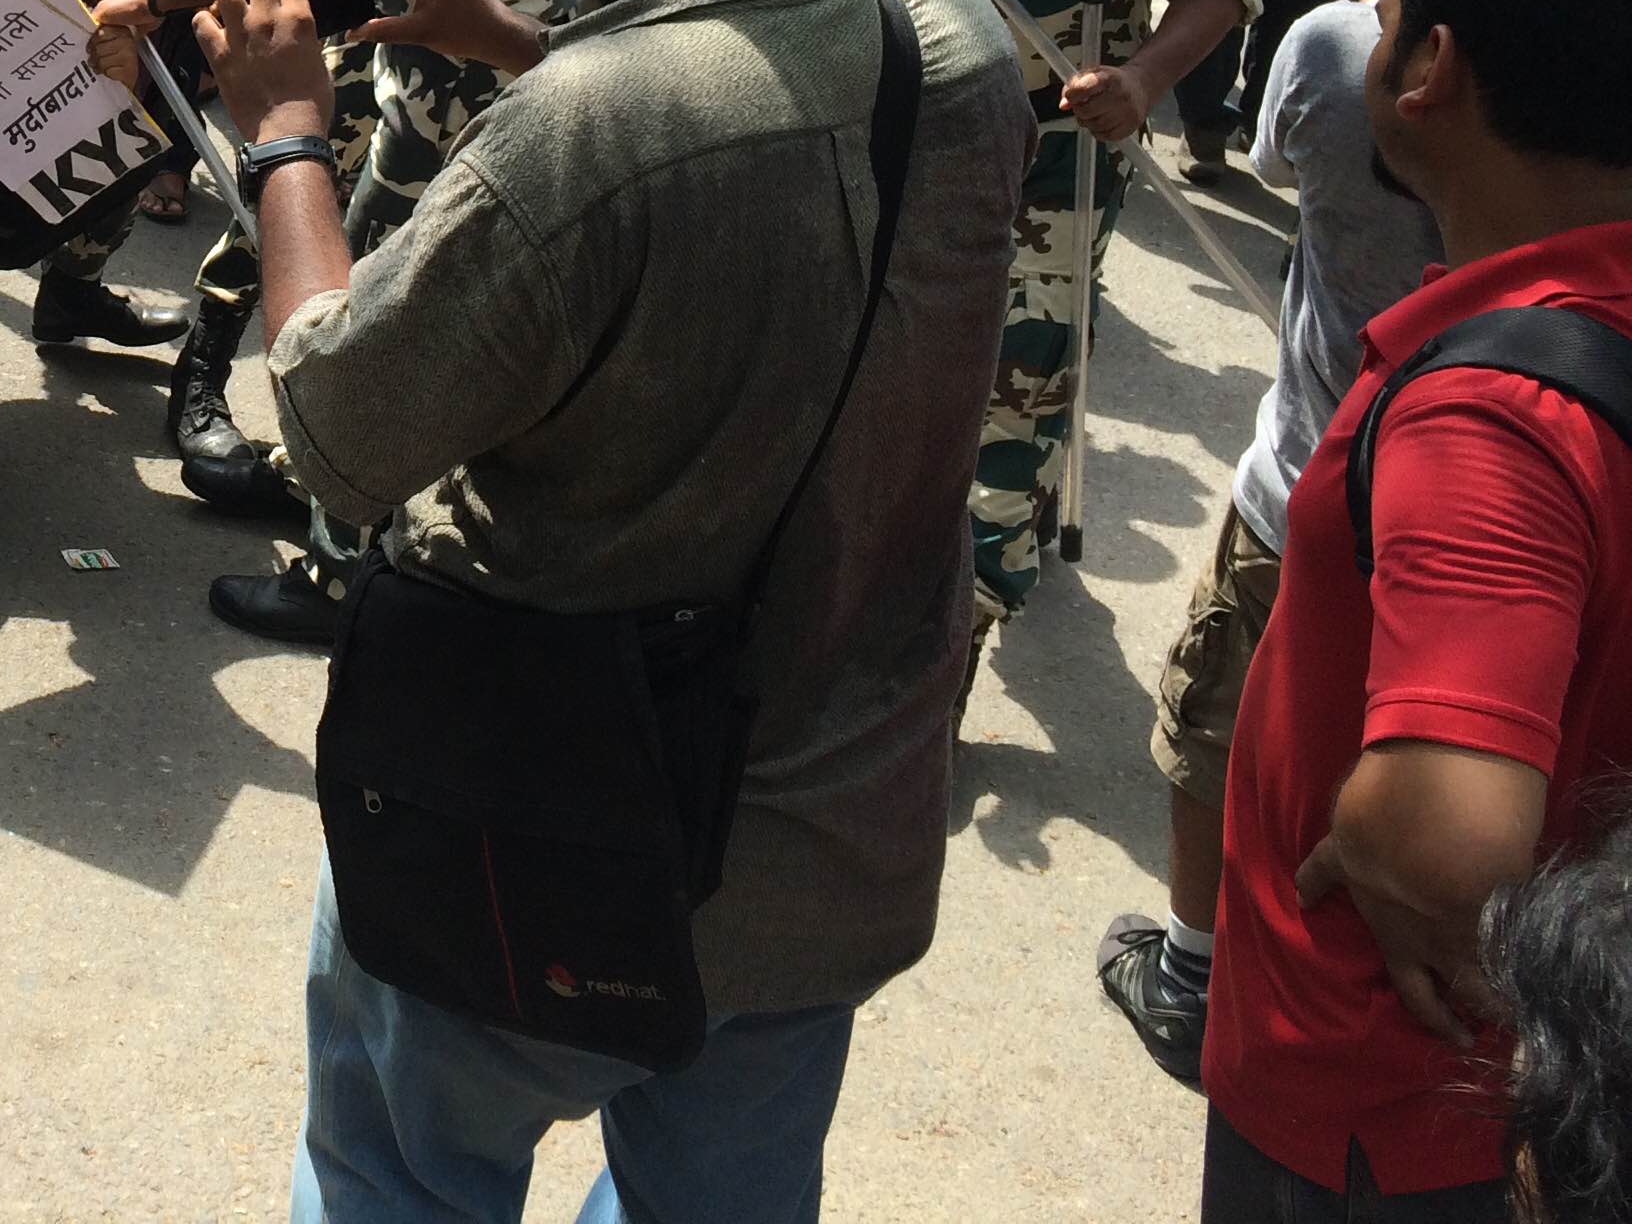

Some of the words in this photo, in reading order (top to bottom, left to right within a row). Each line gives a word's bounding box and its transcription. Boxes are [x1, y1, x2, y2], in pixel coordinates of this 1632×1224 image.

[11, 33, 75, 81] सरकार
[2, 60, 97, 154] मुर्दाबाद!!
[29, 109, 163, 216] KYS
